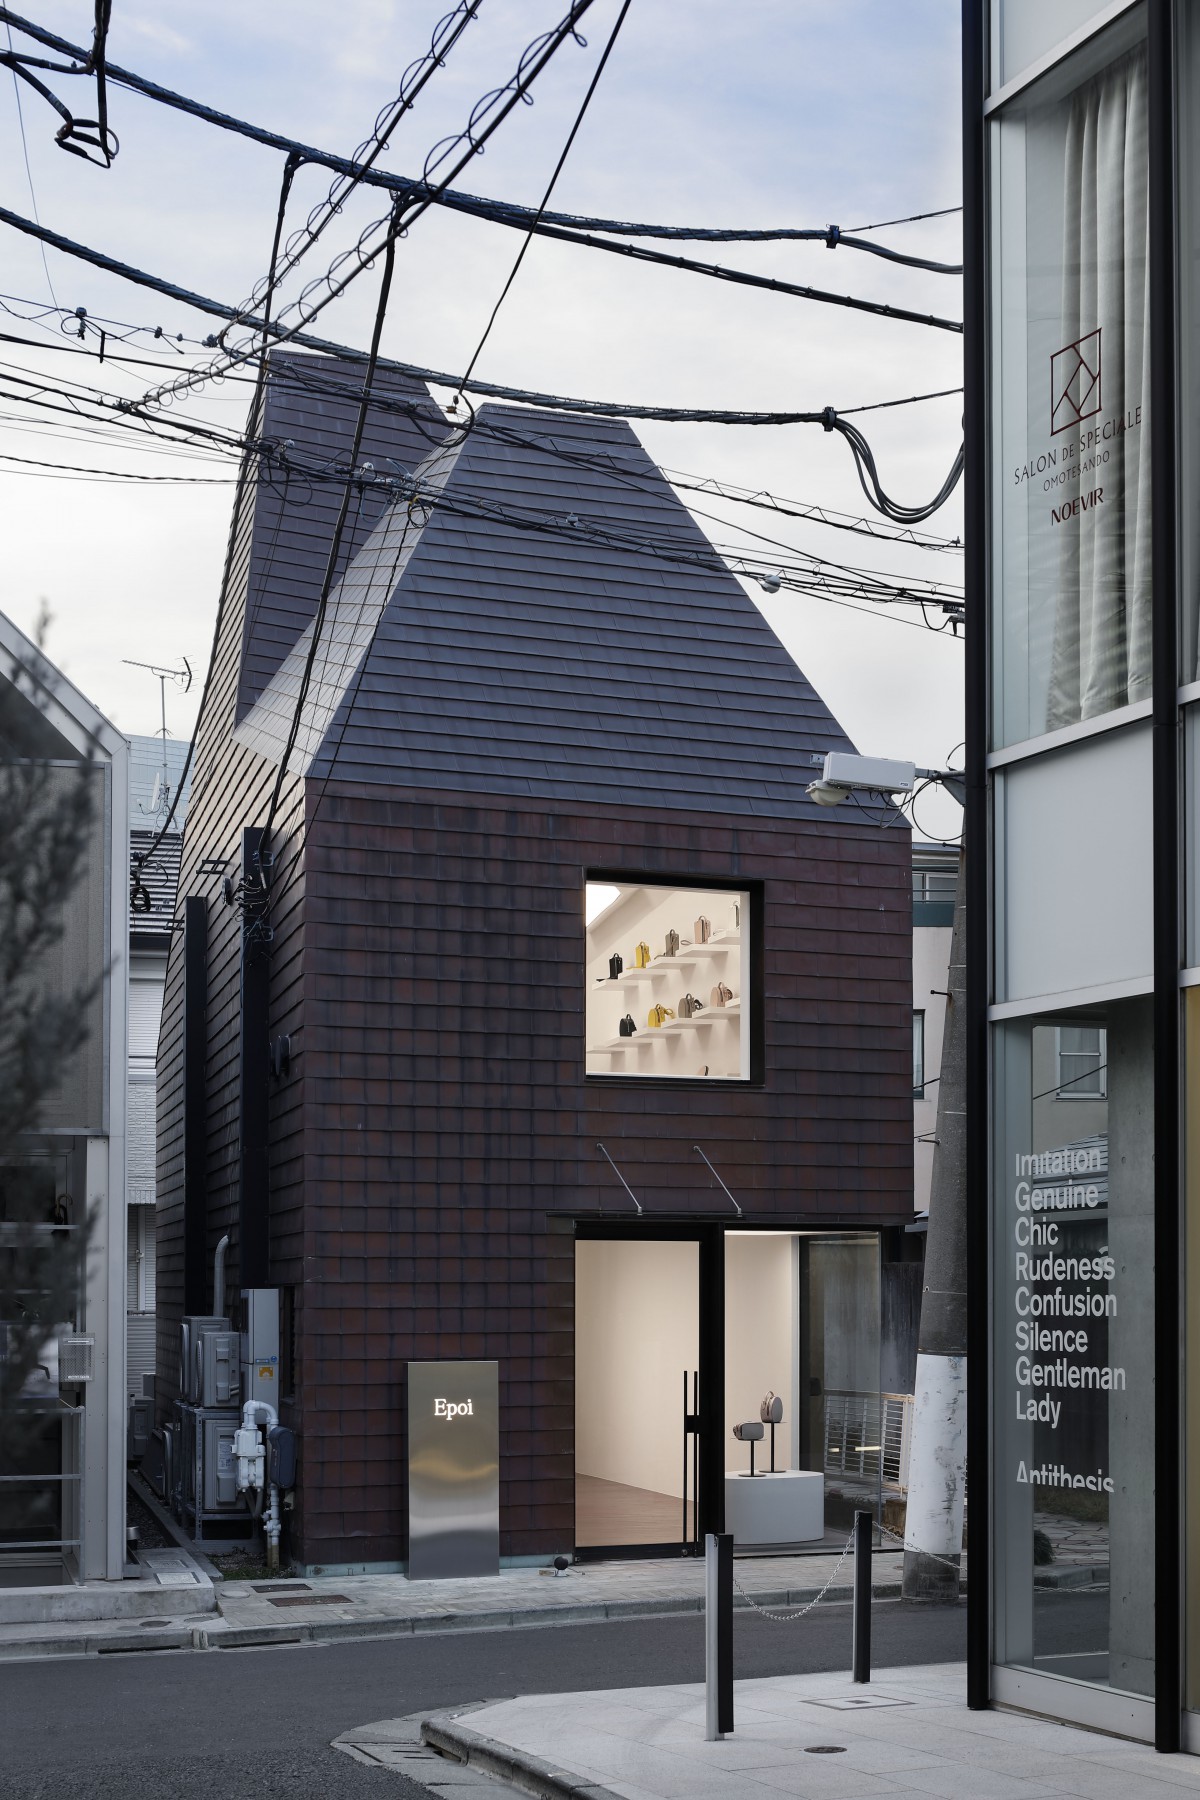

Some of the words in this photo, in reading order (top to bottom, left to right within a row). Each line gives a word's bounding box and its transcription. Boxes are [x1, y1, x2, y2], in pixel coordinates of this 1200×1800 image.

[1014, 449, 1057, 485] SALON
[1062, 444, 1075, 462] DE
[1080, 405, 1142, 452] SPECIALE
[1043, 450, 1110, 492] OMOTESANDO
[1051, 487, 1104, 526] NOEVIR
[1015, 1148, 1101, 1177] Imitation
[1015, 1179, 1099, 1211] Genuine
[1015, 1216, 1059, 1247] Chic
[1015, 1251, 1116, 1281] Rudeness
[1015, 1286, 1118, 1317] Confusion
[1015, 1321, 1089, 1353] Silence
[1015, 1355, 1126, 1391] Gentleman
[434, 1398, 474, 1421] Epoi
[1016, 1390, 1062, 1429] Lady
[1016, 1460, 1115, 1493] Antithesis
